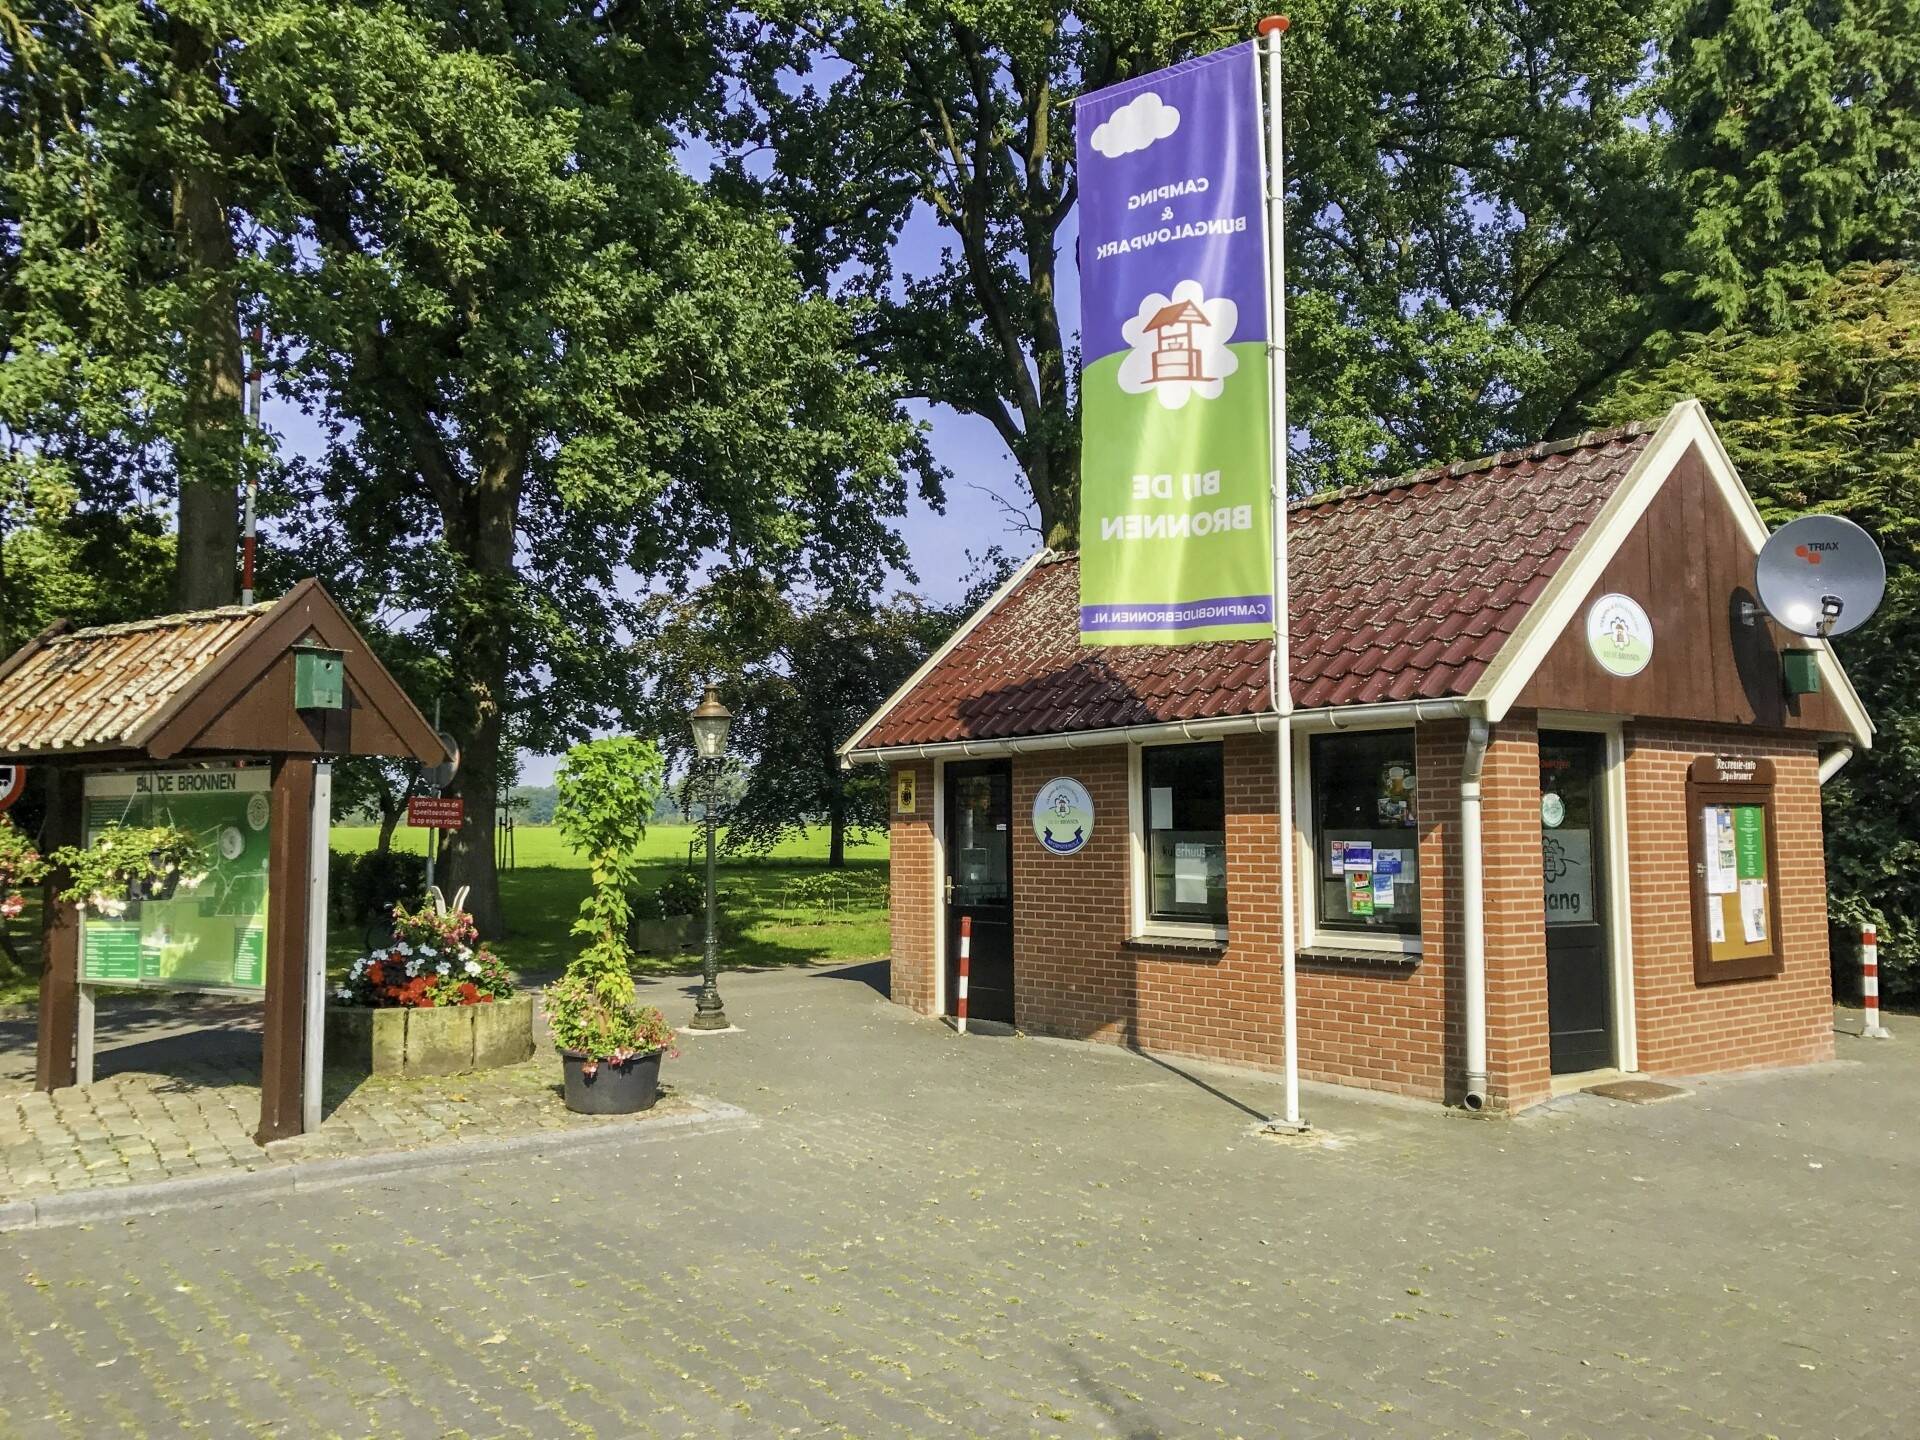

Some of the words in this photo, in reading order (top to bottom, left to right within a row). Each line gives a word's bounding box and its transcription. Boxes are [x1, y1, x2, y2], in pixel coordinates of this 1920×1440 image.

[1807, 542, 1839, 552] TRIAX
[157, 775, 173, 792] DE
[178, 773, 236, 791] BRONNEN
[1544, 893, 1580, 914] ang
